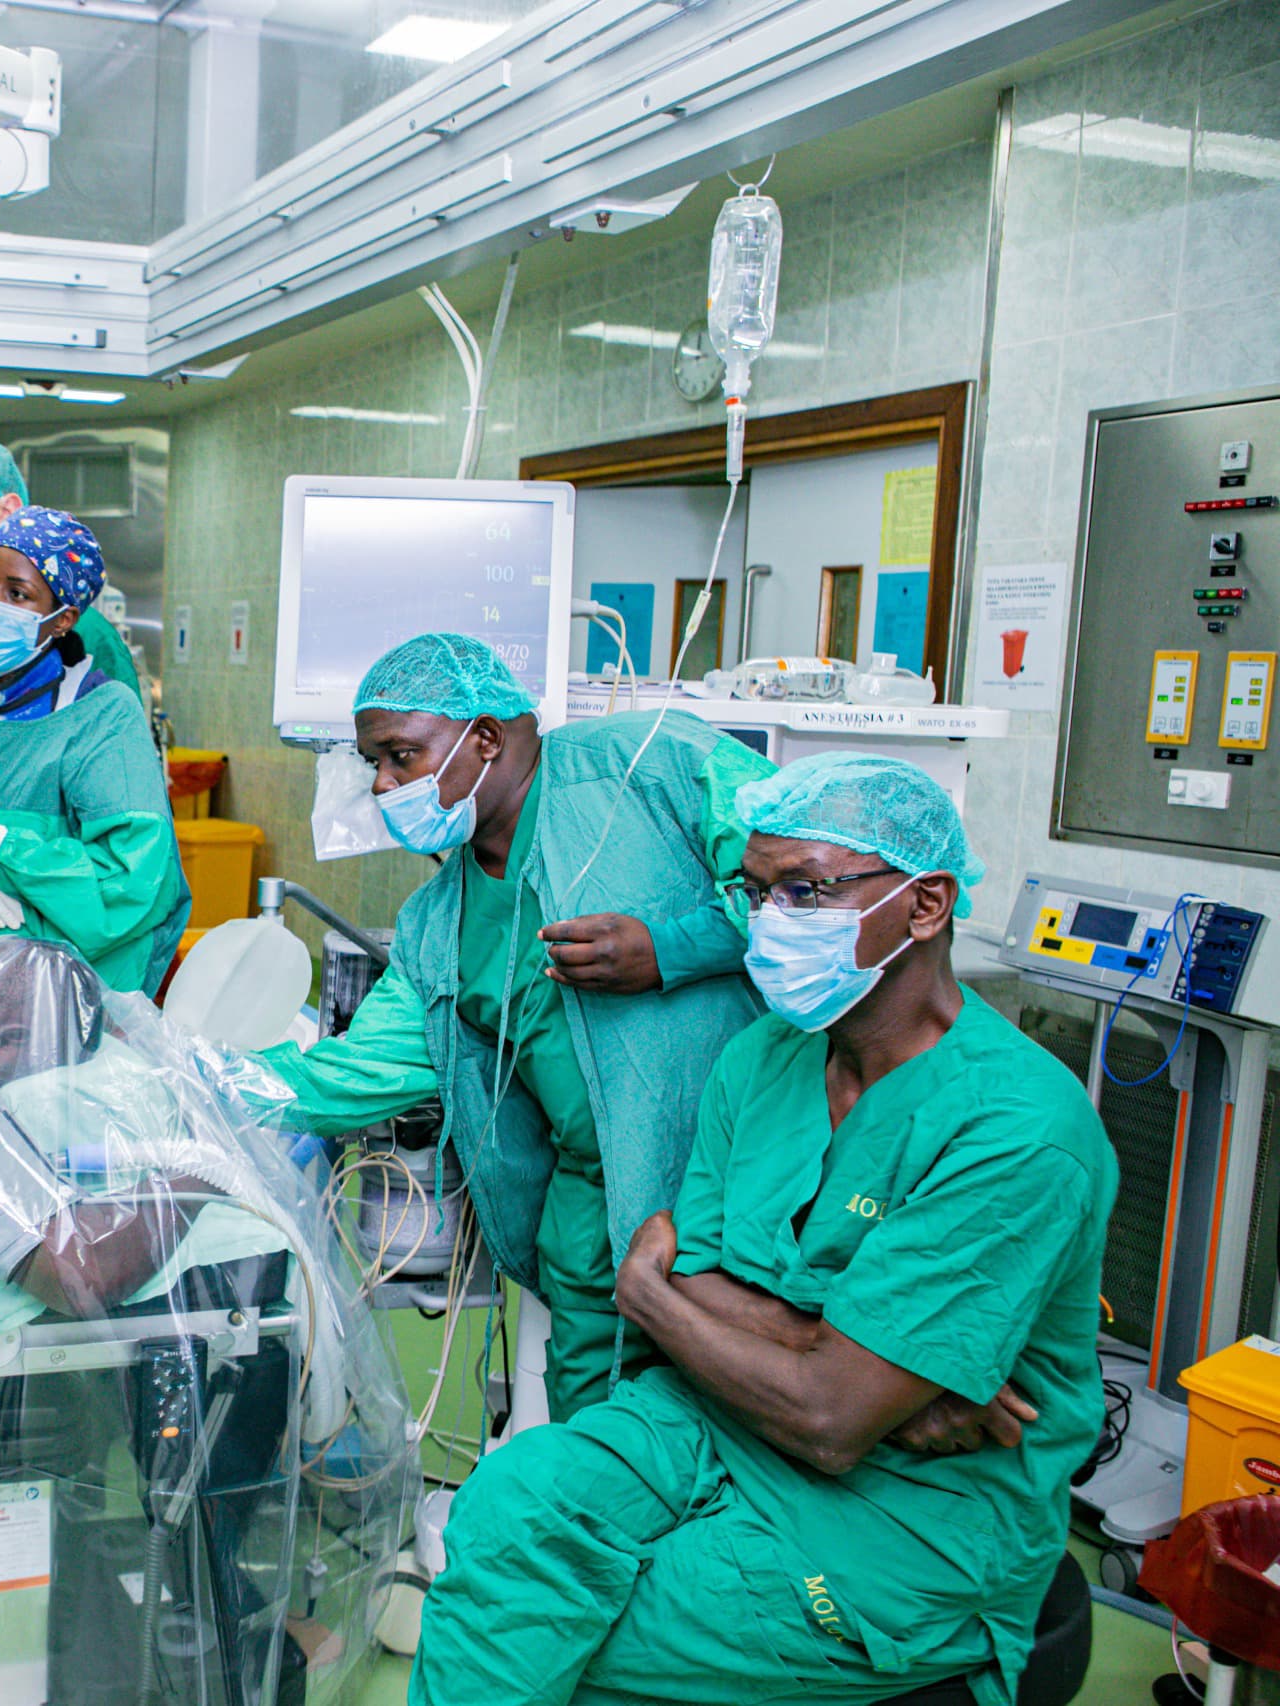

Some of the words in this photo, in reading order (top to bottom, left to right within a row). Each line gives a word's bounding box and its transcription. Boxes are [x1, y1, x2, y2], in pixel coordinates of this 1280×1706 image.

[485, 522, 511, 541] 64
[484, 564, 514, 583] 100
[481, 605, 501, 623] 14
[493, 644, 529, 660] 8/70
[802, 712, 884, 724] ANESTHESIA
[898, 712, 904, 724] 3
[917, 719, 946, 728] WATO
